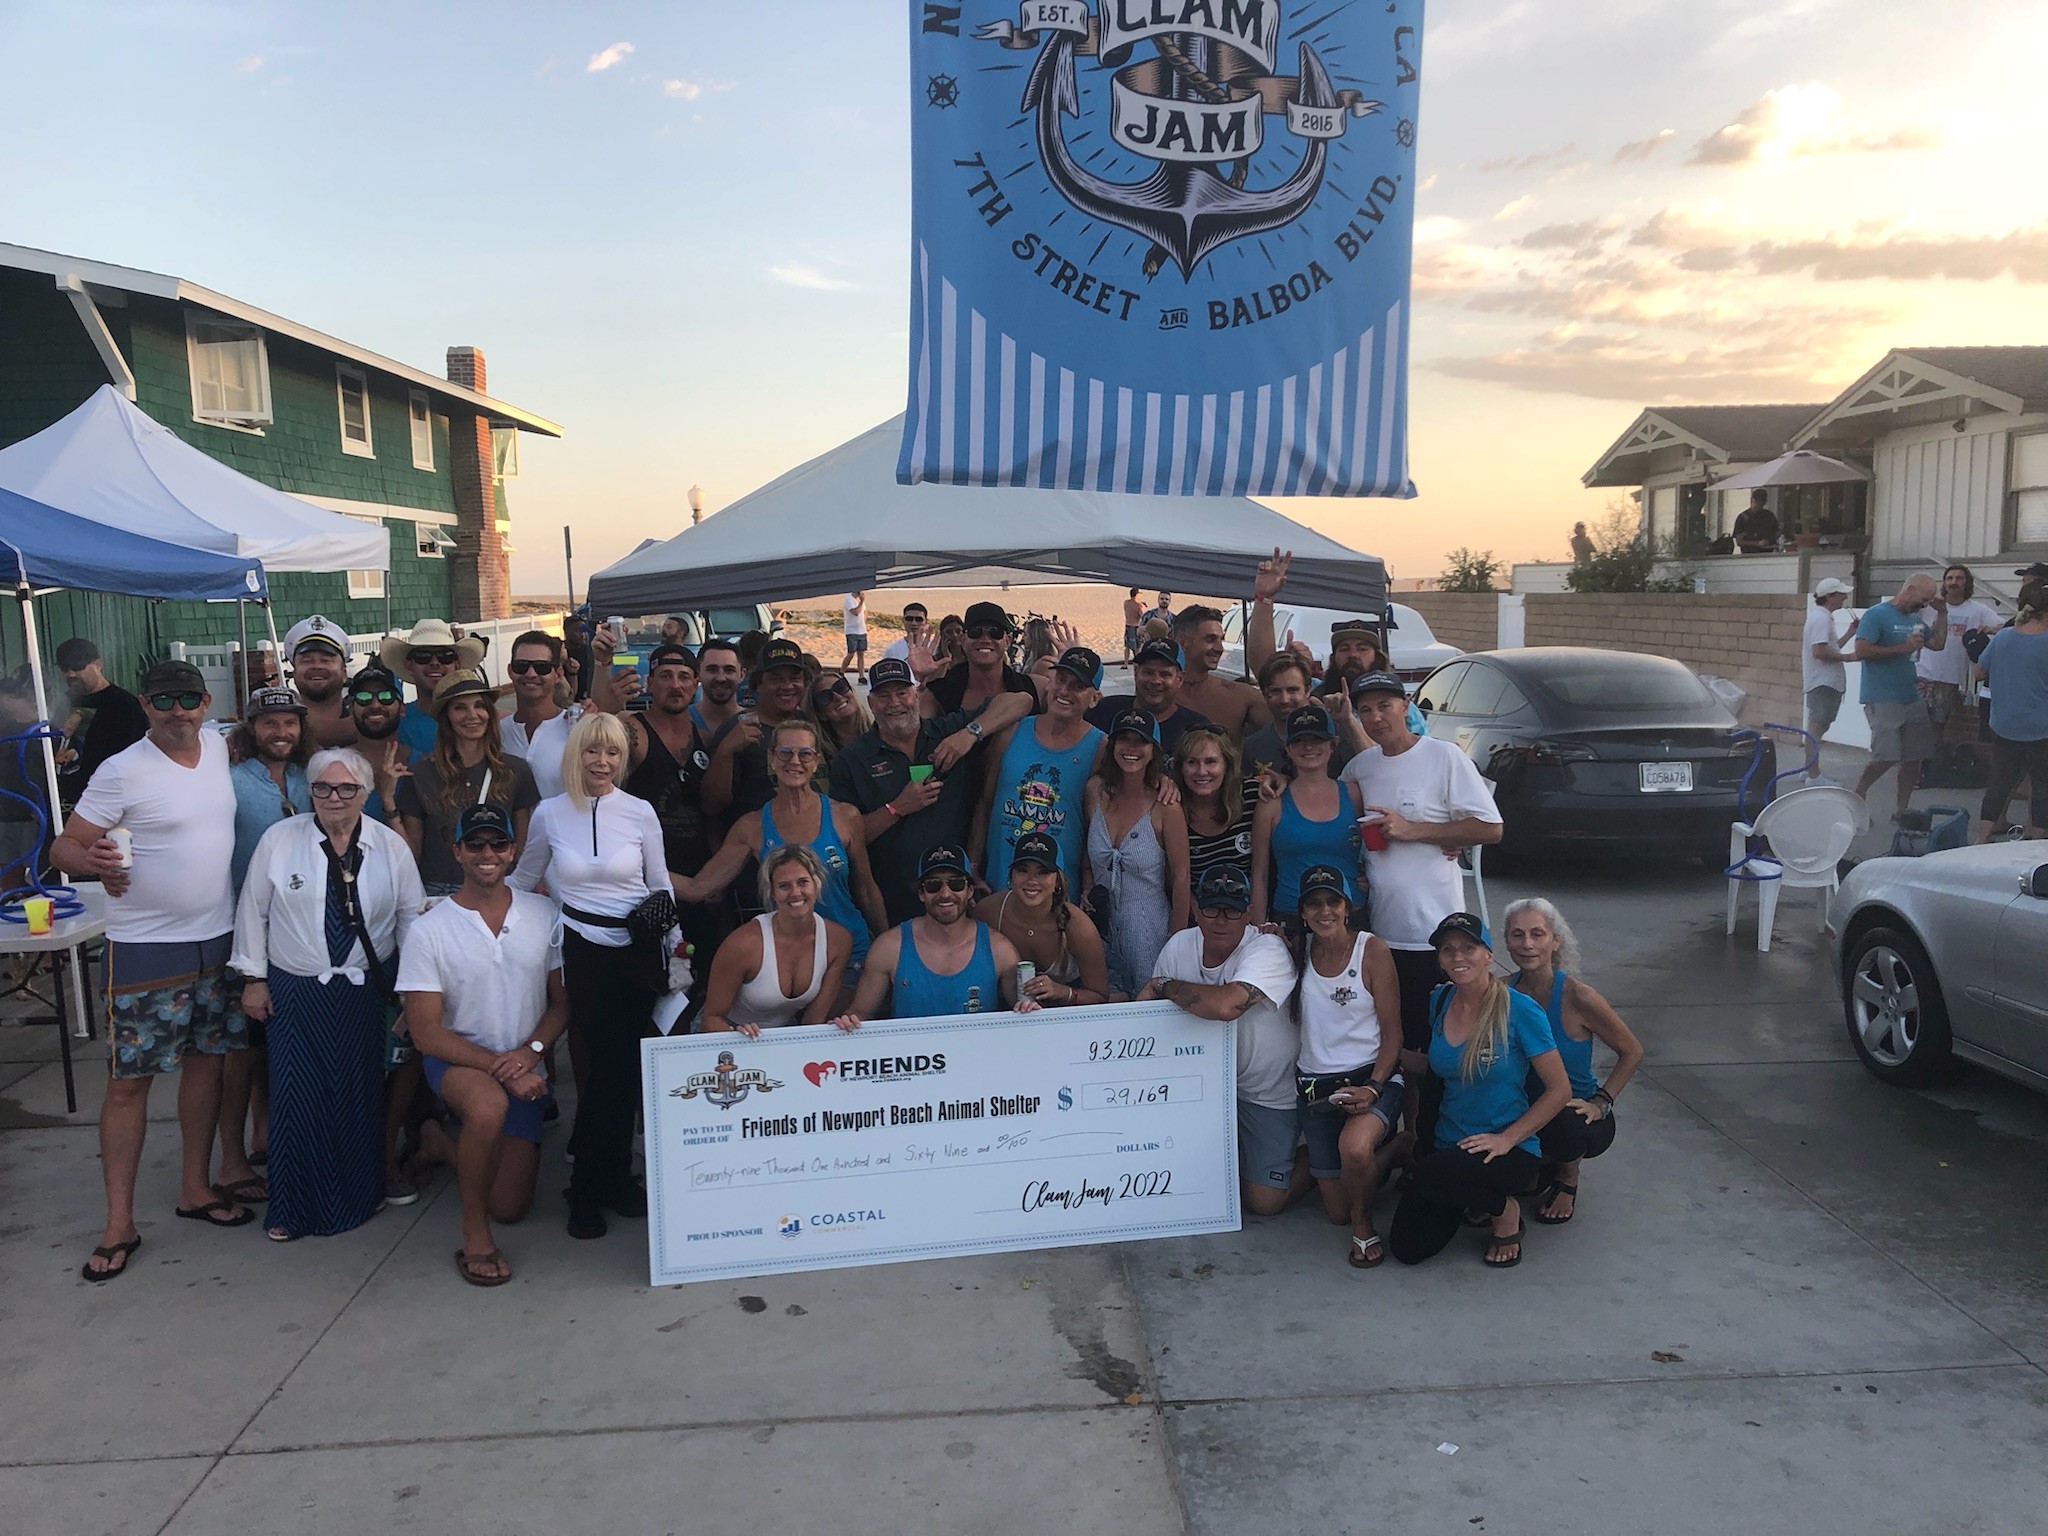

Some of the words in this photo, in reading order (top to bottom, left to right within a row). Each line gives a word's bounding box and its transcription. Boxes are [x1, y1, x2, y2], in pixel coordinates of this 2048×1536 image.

[1038, 4, 1074, 25] EST.
[1124, 104, 1248, 153] JAM
[1301, 112, 1333, 132] 2015
[953, 151, 1013, 228] 7TH
[1011, 233, 1140, 321] STREET
[1159, 311, 1189, 326] AND
[1208, 260, 1334, 331] BALBOA
[1334, 174, 1402, 263] BLVD.
[1089, 1037, 1156, 1060] 9.3.2022
[1174, 1045, 1205, 1057] DATE
[840, 1053, 946, 1077] FRIENDS
[690, 1075, 716, 1087] CLAM
[738, 1071, 761, 1083] JAM
[1057, 1085, 1073, 1112] $
[1103, 1084, 1169, 1106] 29,169
[742, 1115, 797, 1138] Friends
[803, 1112, 817, 1133] of
[823, 1107, 885, 1132] Newport
[891, 1102, 932, 1125] Beach
[938, 1097, 984, 1121] Animal
[991, 1094, 1040, 1117] Shelter
[683, 1127, 698, 1135] PAY
[701, 1126, 714, 1134] TO
[715, 1124, 734, 1132] THE
[683, 1136, 716, 1146] ORDER
[1116, 1142, 1160, 1153] DOLLARS
[811, 1157, 828, 1172] One
[876, 1153, 891, 1165] and
[904, 1144, 936, 1164] Sixty
[944, 1143, 968, 1157] Nine
[1119, 1170, 1173, 1198] 2022
[811, 1209, 886, 1226] COASTAL
[687, 1232, 719, 1241] PROUD
[720, 1228, 763, 1238] SPONSOR
